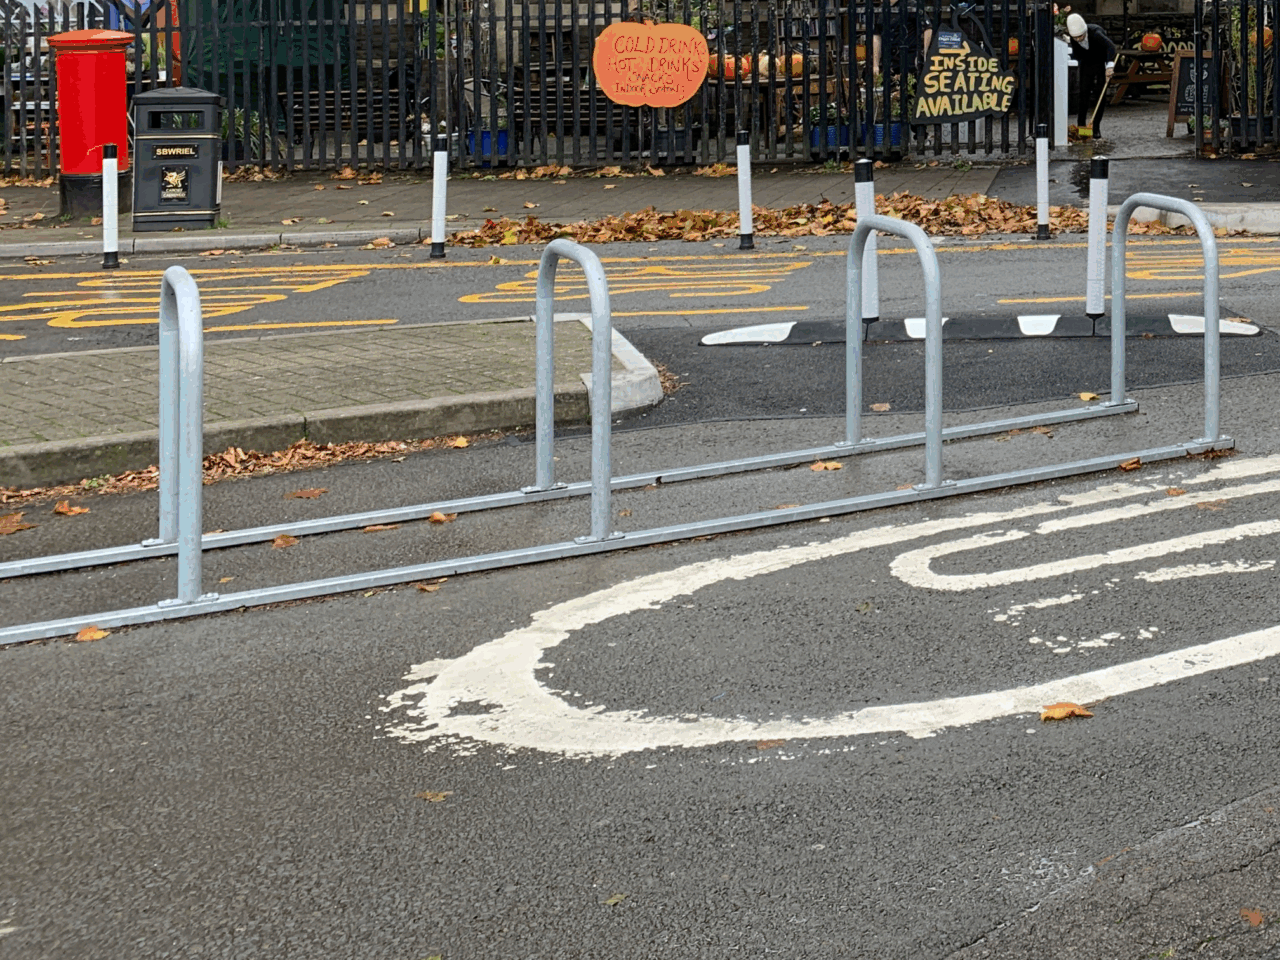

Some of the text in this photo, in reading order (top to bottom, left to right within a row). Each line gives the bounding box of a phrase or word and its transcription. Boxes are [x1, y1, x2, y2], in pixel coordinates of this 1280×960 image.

[615, 35, 706, 56] COLD DRINKS
[608, 56, 700, 74] HOT DRINKS
[930, 56, 999, 72] INSIDE
[924, 71, 1015, 94] SEATING
[916, 92, 1012, 119] AVAILABLE
[156, 147, 195, 156] SBWRIEL
